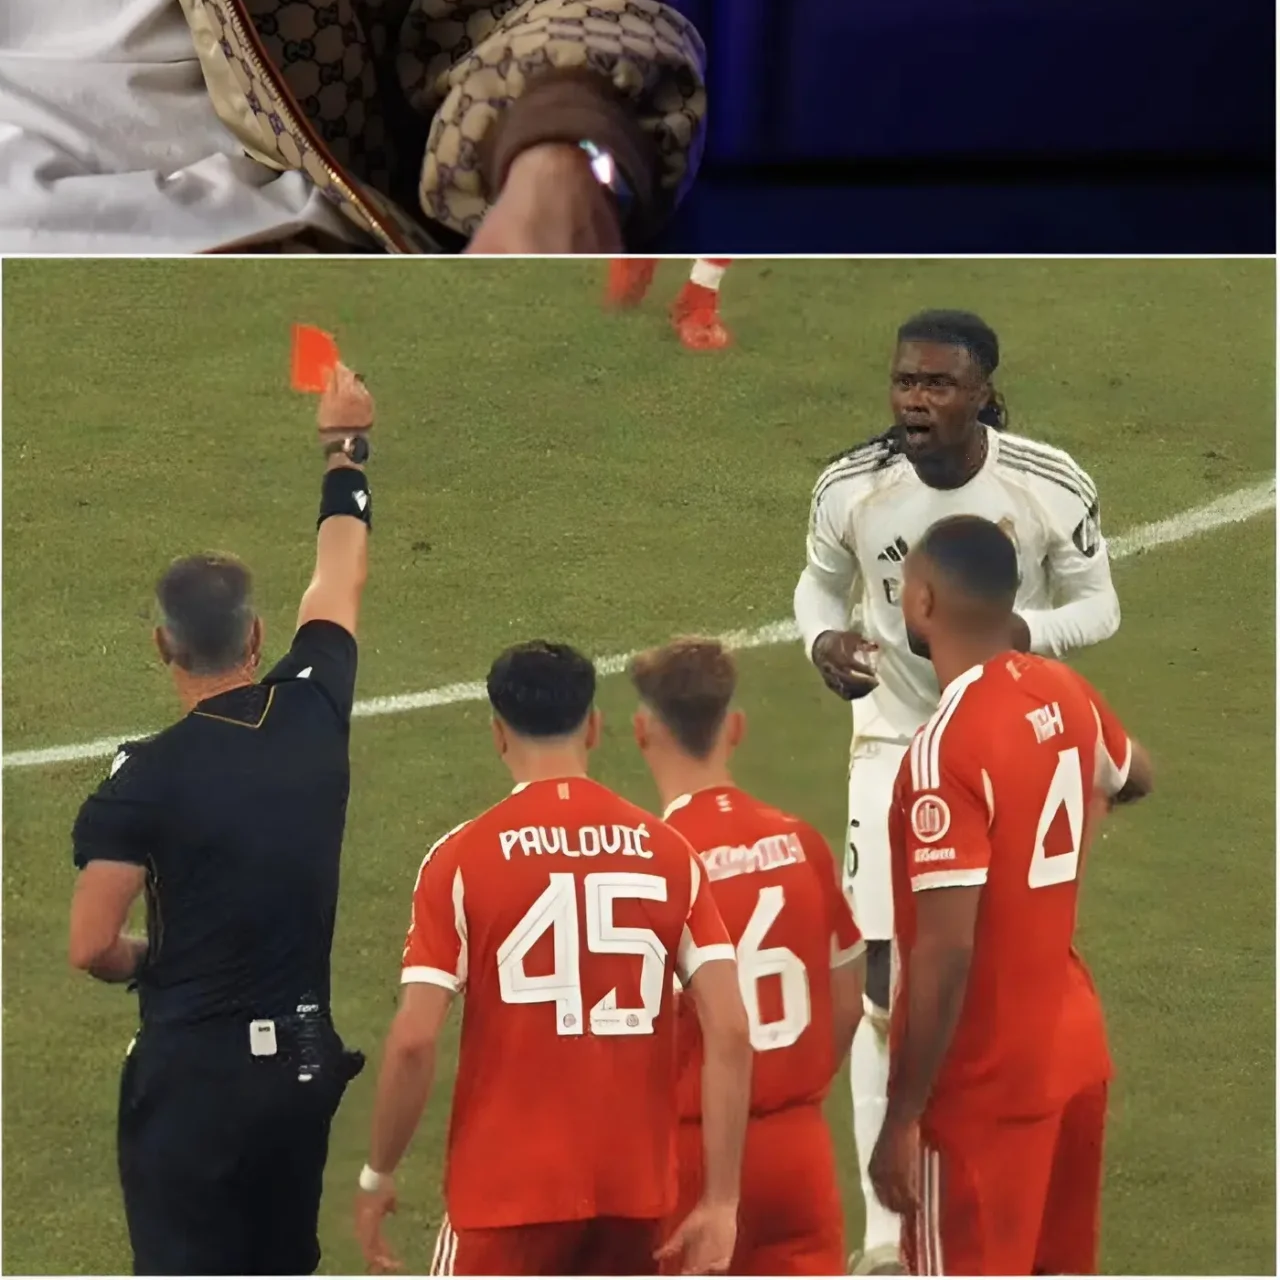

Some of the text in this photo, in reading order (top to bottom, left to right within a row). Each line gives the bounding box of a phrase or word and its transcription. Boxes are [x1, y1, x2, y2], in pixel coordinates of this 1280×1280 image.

[499, 823, 654, 860] PAVLOVIĆ
[1028, 746, 1084, 889] 4
[496, 872, 668, 1036] 45
[736, 885, 812, 1051] 6
